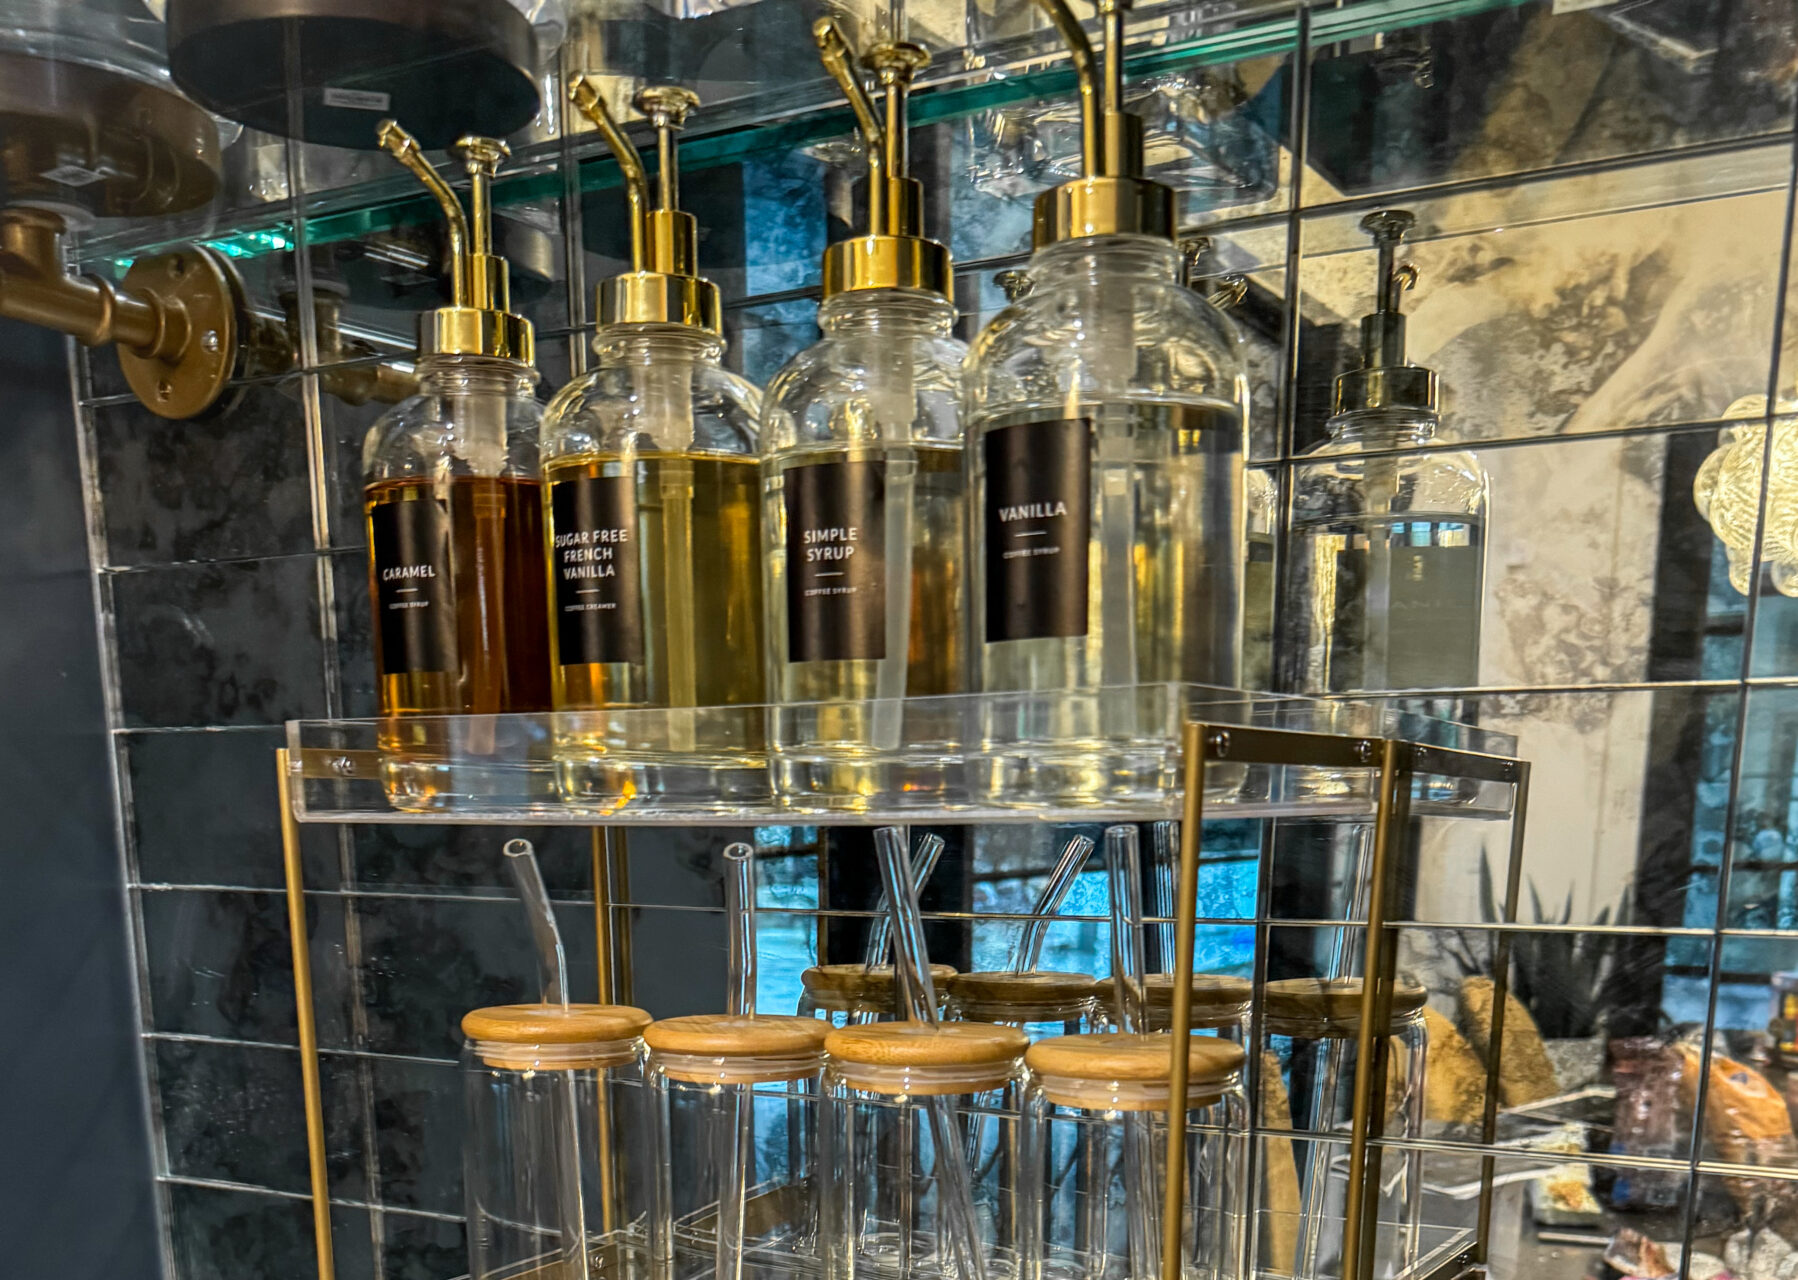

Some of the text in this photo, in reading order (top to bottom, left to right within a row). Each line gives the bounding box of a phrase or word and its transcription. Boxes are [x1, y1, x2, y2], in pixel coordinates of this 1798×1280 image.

[998, 501, 1066, 522] VANILLA
[555, 529, 628, 548] SUGAR FREE
[804, 527, 857, 543] SIMPLE
[563, 546, 613, 563] FRENCH
[807, 545, 854, 562] SYRUP
[383, 564, 436, 581] CARAMEL
[563, 564, 615, 580] VANILLA
